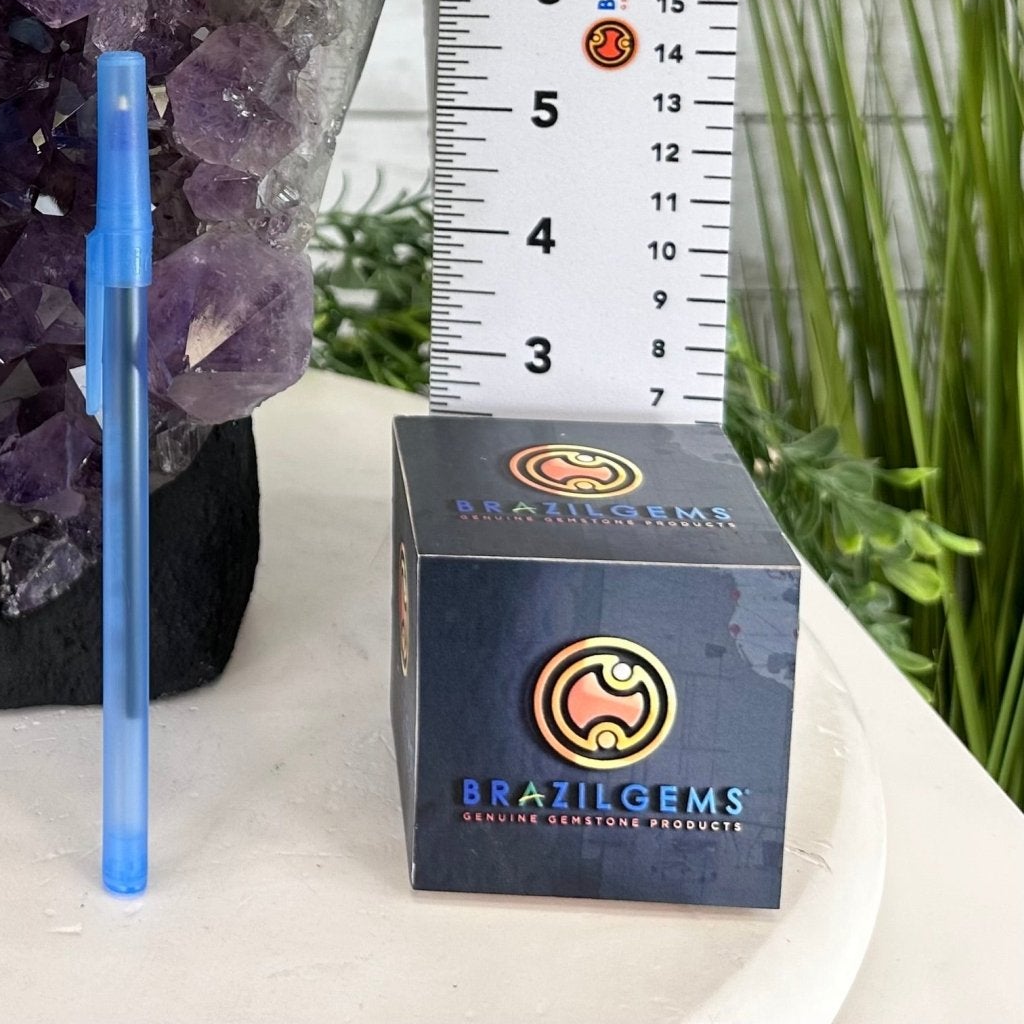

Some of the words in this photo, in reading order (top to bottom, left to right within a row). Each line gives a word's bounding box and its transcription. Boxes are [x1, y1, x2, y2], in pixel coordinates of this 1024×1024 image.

[654, 43, 684, 64] 14
[530, 90, 559, 129] 5
[653, 93, 681, 113] 13
[651, 142, 680, 163] 12
[651, 192, 677, 212] 11
[526, 217, 556, 255] 4
[647, 240, 677, 261] 10
[653, 290, 668, 310] 9
[524, 336, 552, 375] 3
[652, 339, 666, 359] 8
[650, 387, 665, 407] 7
[455, 499, 732, 521] BRAZILGEMS
[462, 778, 746, 816] BRAZILGEMS
[463, 812, 537, 823] GENUINE
[548, 815, 639, 827] GEMSTONE
[650, 819, 741, 831] PRODUCTS
